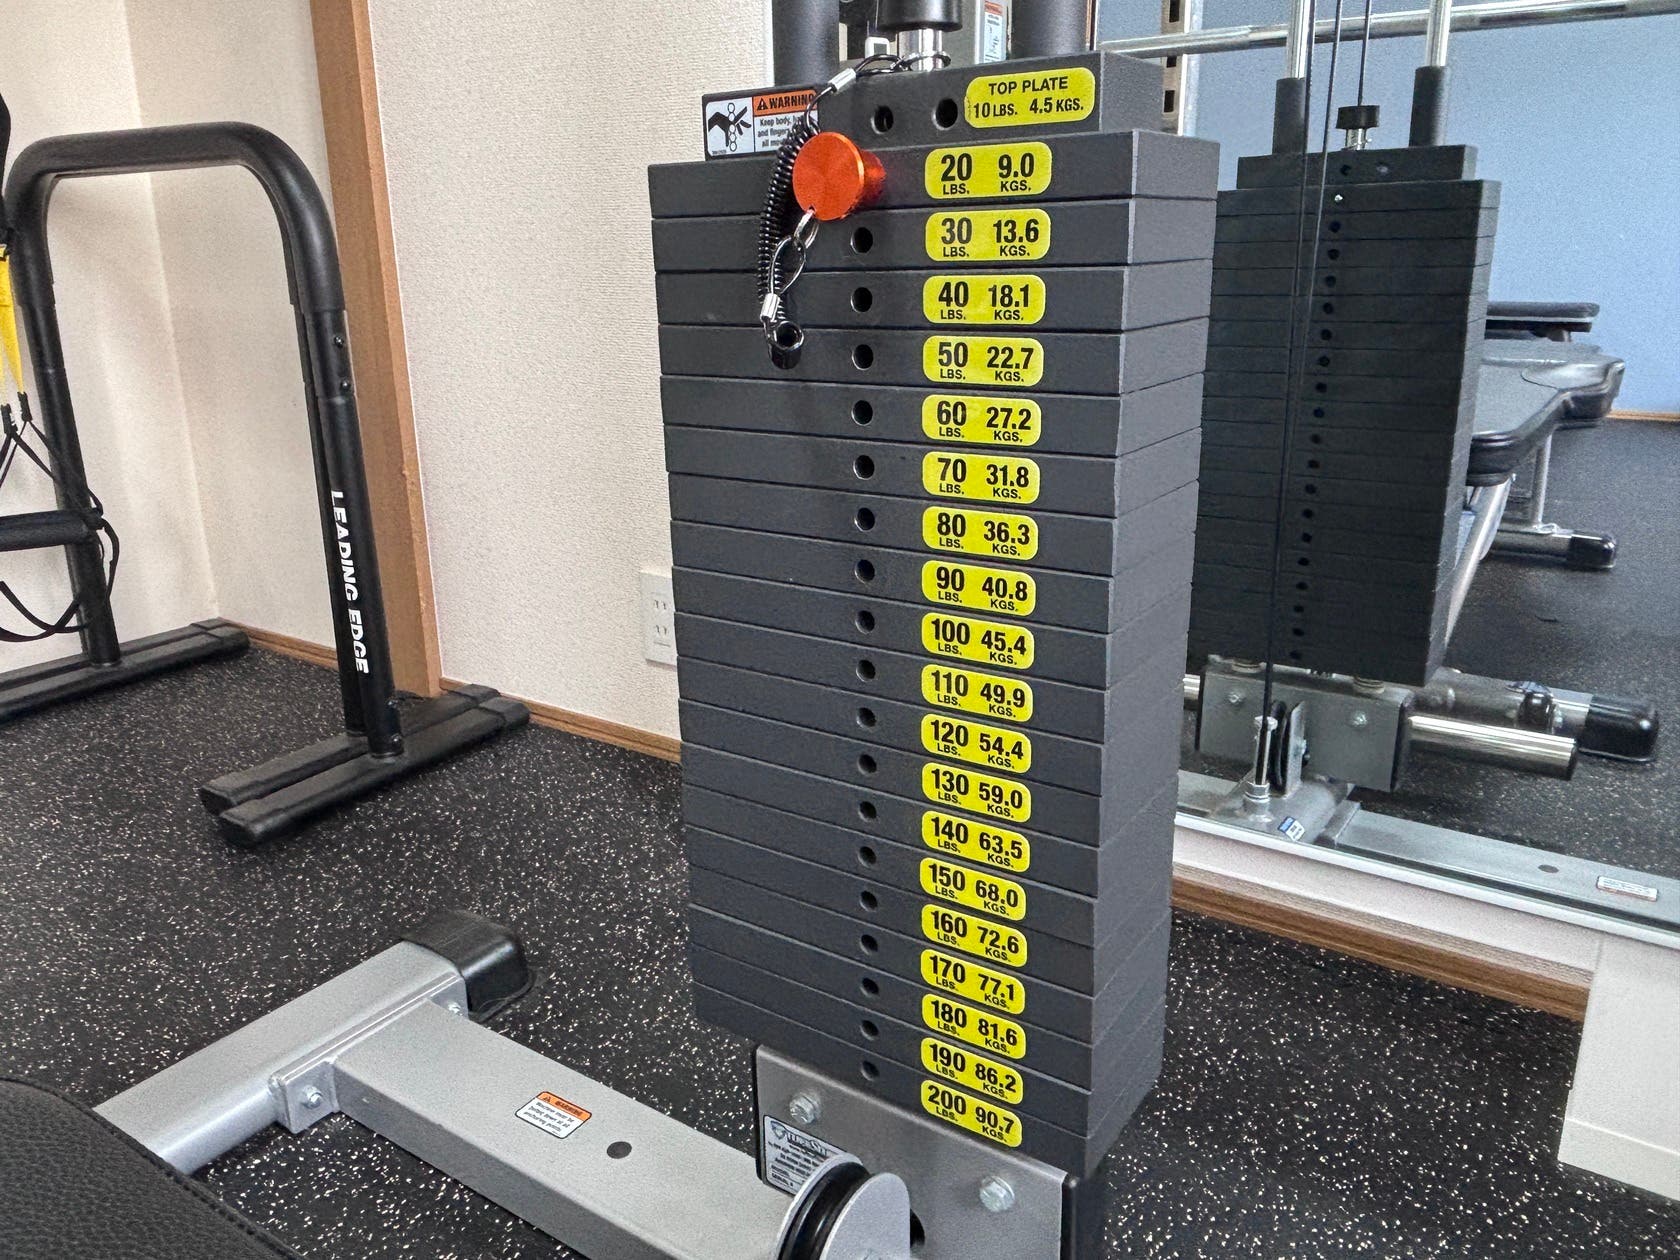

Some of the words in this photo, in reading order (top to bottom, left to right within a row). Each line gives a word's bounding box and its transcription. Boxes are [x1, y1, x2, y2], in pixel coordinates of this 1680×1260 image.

[989, 82, 1018, 96] TOP
[1023, 76, 1069, 93] PLATE
[974, 102, 991, 118] 10
[993, 103, 1018, 117] LBS.
[1029, 97, 1053, 114] 4.5
[1056, 97, 1084, 112] KGS.
[770, 128, 790, 138] finger
[941, 153, 972, 181] 20
[999, 153, 1034, 178] 9.0
[943, 183, 969, 195] LBS.
[1001, 180, 1031, 192] KGS.
[941, 218, 972, 244] 30
[993, 219, 1039, 243] 13.6
[943, 247, 969, 257] LBS.
[1000, 245, 1030, 256] KGS.
[939, 281, 968, 307] 40
[988, 284, 1029, 307] 18.1
[941, 310, 965, 320] LBS.
[995, 310, 1023, 320] KGS.
[939, 342, 968, 367] 50
[987, 346, 1034, 369] 22.7
[940, 369, 965, 379] LBS.
[995, 371, 1023, 381] KGS.
[937, 401, 966, 426] 60
[987, 407, 1031, 430] 27.2
[939, 427, 964, 437] LBS.
[994, 431, 1022, 442] KGS.
[938, 458, 966, 482] 70
[986, 464, 1029, 487] 31.8
[940, 484, 964, 494] LBS.
[993, 487, 1021, 499] KGS.
[937, 513, 966, 537] 80
[984, 521, 1029, 545] 36.3
[940, 537, 963, 549] LBS.
[993, 543, 1020, 556] KGS.
[331, 490, 358, 601] LEADING
[349, 608, 369, 674] EDGE
[937, 567, 964, 591] 90
[982, 577, 1027, 601] 40.8
[939, 591, 962, 603] LBS.
[991, 599, 1017, 611] KGS.
[931, 619, 970, 645] 100
[981, 630, 1026, 655] 45.4
[938, 643, 961, 655] LBS.
[990, 652, 1017, 665] KGS.
[932, 670, 968, 696] 110
[980, 683, 1025, 708] 49.9
[938, 694, 961, 706] LBS.
[989, 704, 1015, 717] KGS.
[931, 720, 968, 746] 120
[980, 733, 1023, 760] 54.4
[938, 743, 960, 756] LBS.
[988, 754, 1014, 768] KGS.
[932, 769, 969, 795] 130
[979, 782, 1022, 809] 59.0
[938, 792, 961, 804] LBS.
[987, 804, 1013, 818] KGS.
[931, 817, 968, 844] 140
[979, 832, 1022, 859] 63.5
[938, 839, 960, 853] LBS.
[988, 853, 1013, 867] KGS.
[929, 864, 965, 891] 150
[976, 880, 1018, 907] 68.0
[936, 886, 957, 899] LBS.
[984, 901, 1009, 915] KGS.
[931, 911, 967, 937] 160
[977, 926, 1019, 954] 72.6
[938, 932, 959, 946] LBS.
[985, 947, 1010, 961] KGS.
[930, 955, 965, 983] 170
[978, 974, 1014, 1001] 77.1
[936, 977, 958, 990] LBS.
[985, 993, 1009, 1009] KGS.
[931, 1000, 967, 1028] 180
[978, 1019, 1017, 1046] 81.6
[938, 1021, 959, 1035] LBS.
[985, 1038, 1010, 1053] KGS.
[930, 1044, 965, 1072] 190
[975, 1063, 1016, 1093] 86.2
[936, 1064, 958, 1079] LBS.
[983, 1083, 1007, 1099] KGS.
[928, 1085, 966, 1115] 200
[976, 1107, 1014, 1134] 90.7
[936, 1107, 958, 1121] LBS.
[982, 1126, 1006, 1142] KGS.
